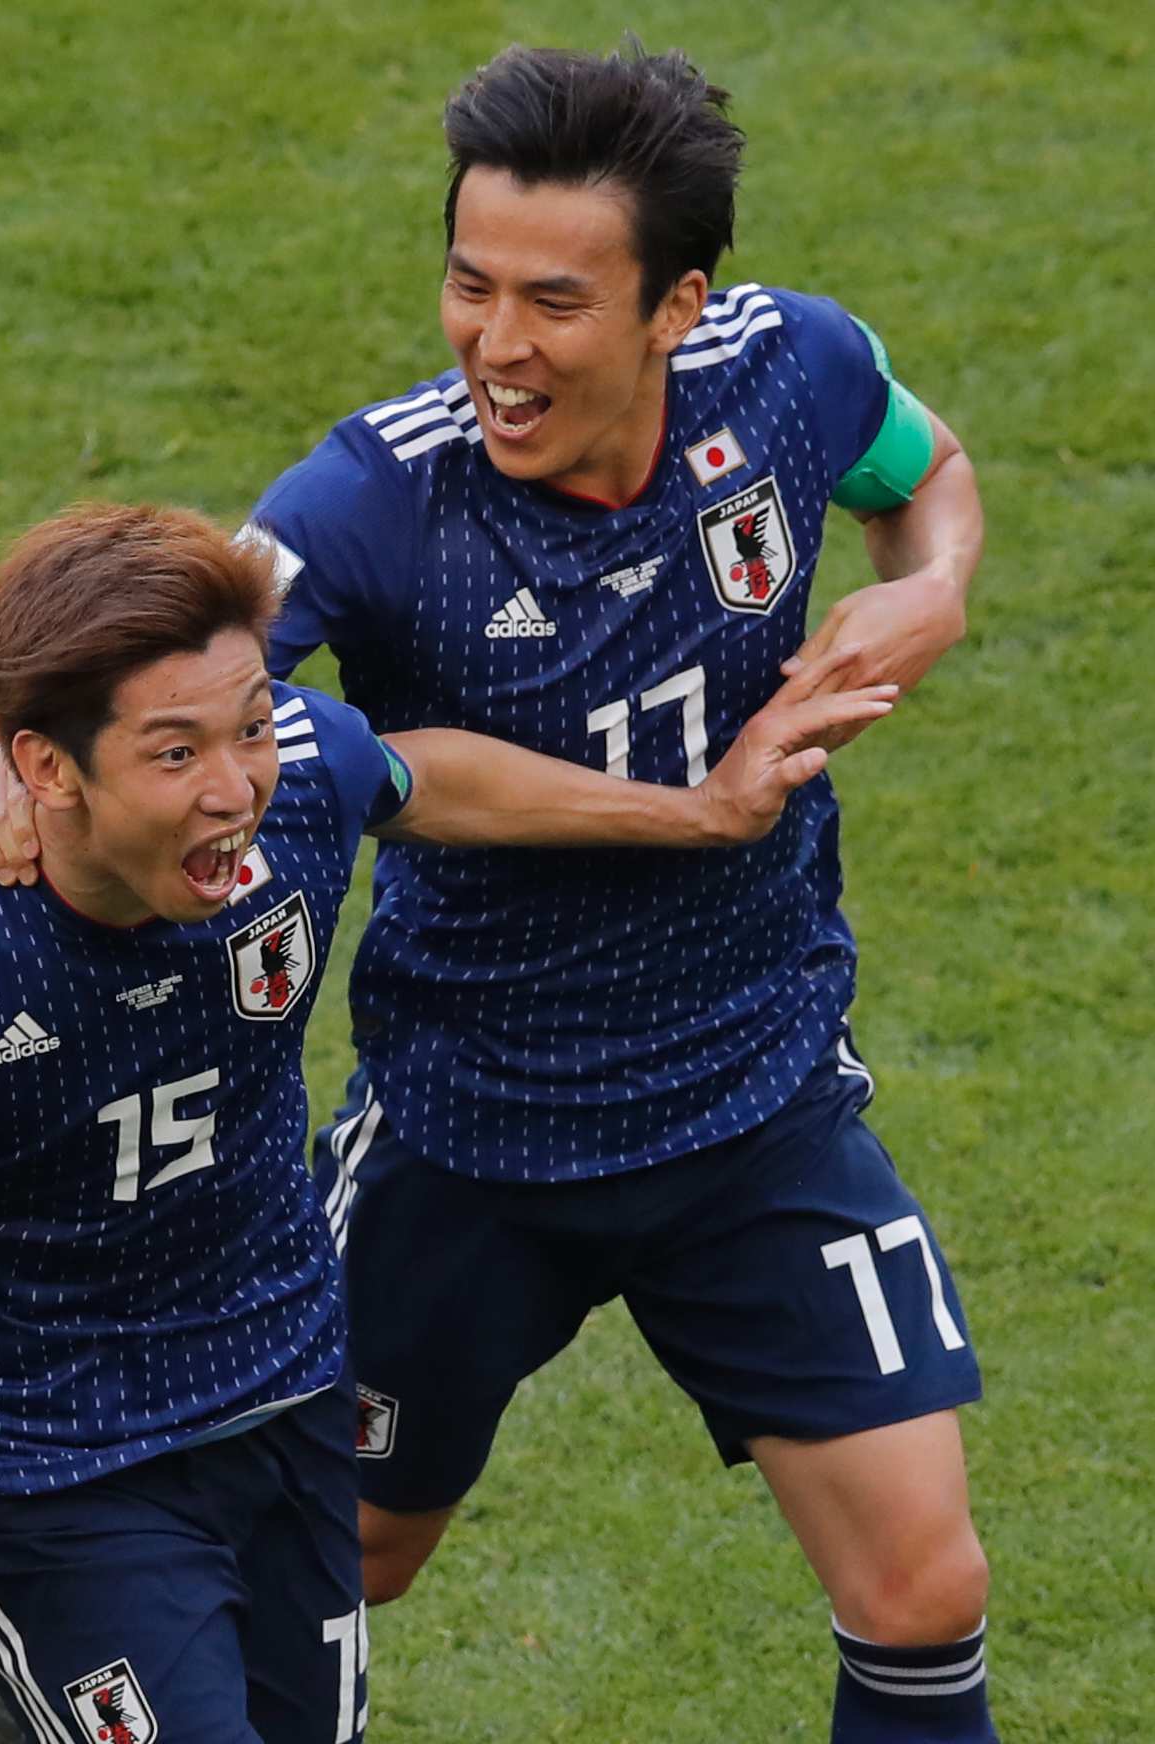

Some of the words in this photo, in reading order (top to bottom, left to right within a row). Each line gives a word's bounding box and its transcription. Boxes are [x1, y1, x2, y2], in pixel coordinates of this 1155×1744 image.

[719, 490, 760, 519] JAPAN
[484, 617, 557, 639] adidas
[587, 665, 709, 788] 17
[247, 908, 287, 940] JAPAN
[97, 1066, 221, 1202] 15
[820, 1214, 966, 1376] 17
[79, 1670, 114, 1693] JAPAN
[322, 1597, 369, 1744] 1
